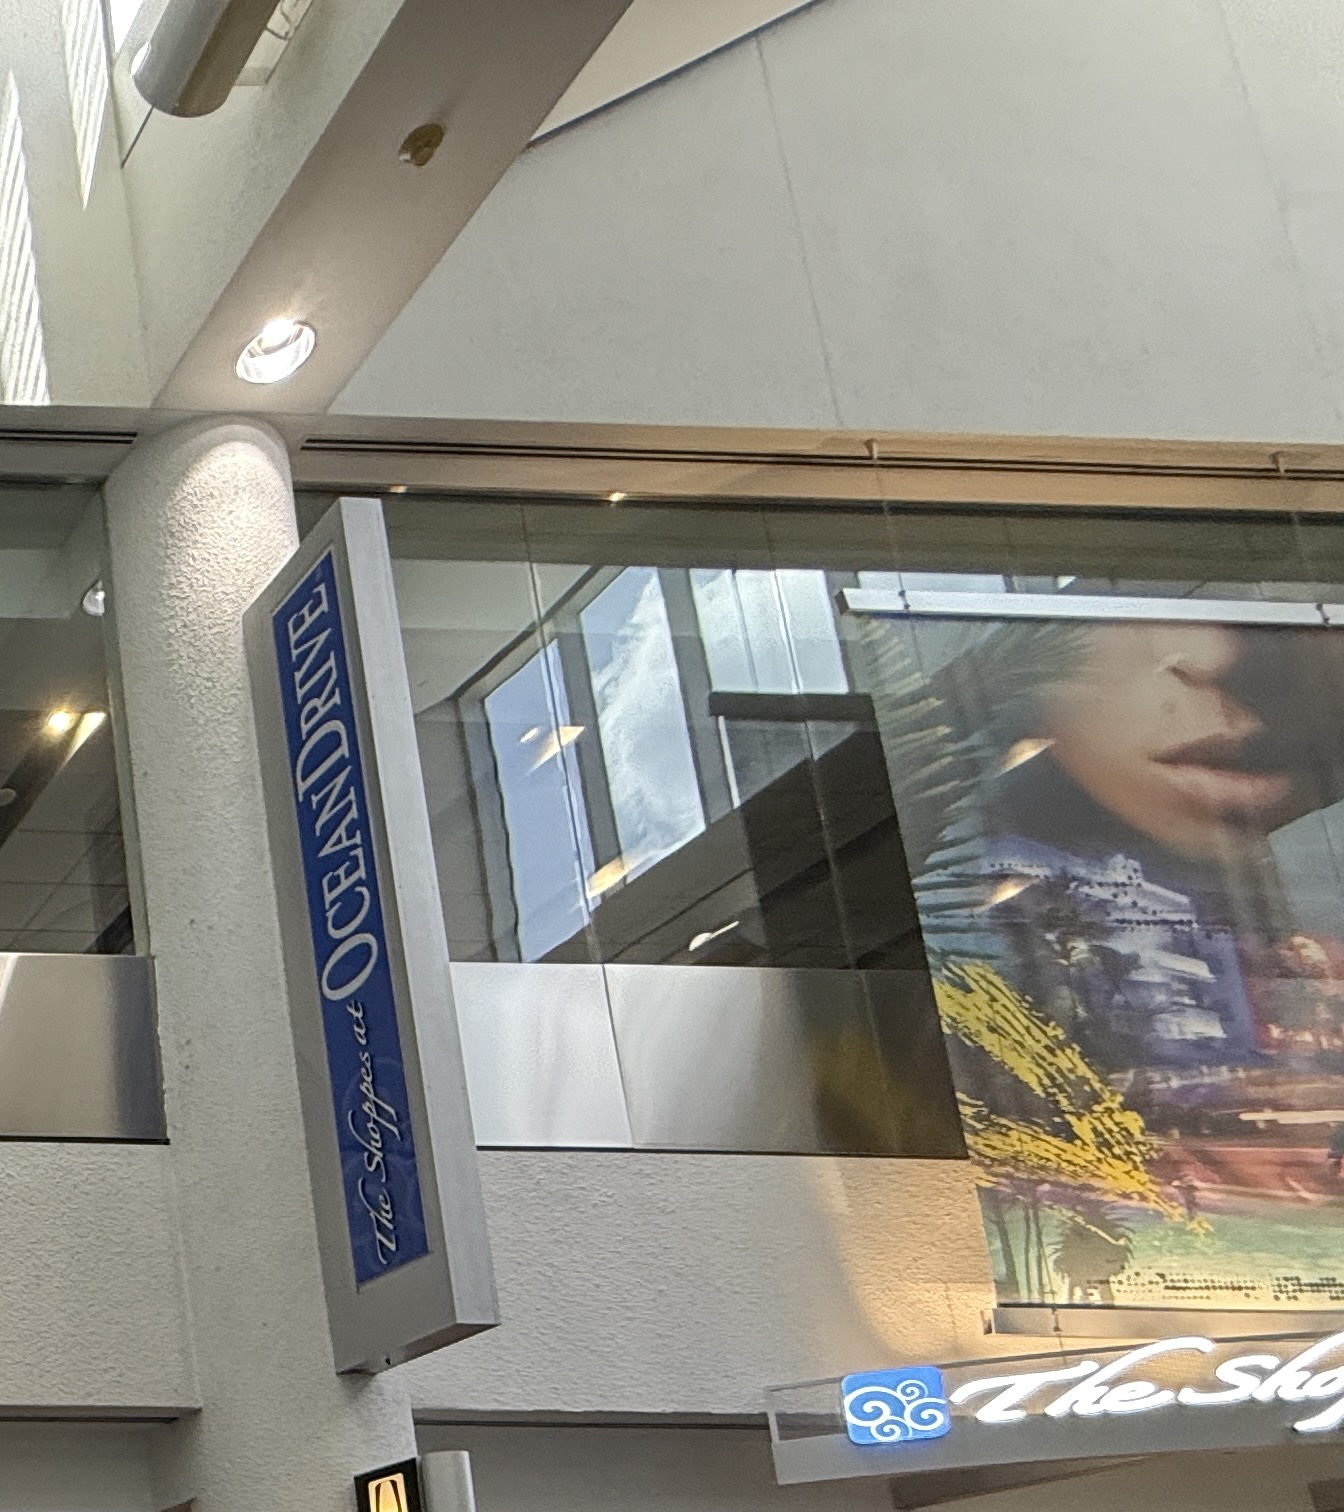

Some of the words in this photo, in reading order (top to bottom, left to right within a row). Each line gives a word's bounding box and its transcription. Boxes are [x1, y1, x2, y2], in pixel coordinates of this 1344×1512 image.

[346, 1000, 368, 1046] at
[348, 1051, 402, 1183] Shoppes
[358, 1177, 398, 1265] The
[949, 1336, 1215, 1422] The
[1177, 1331, 1344, 1432] Sho
